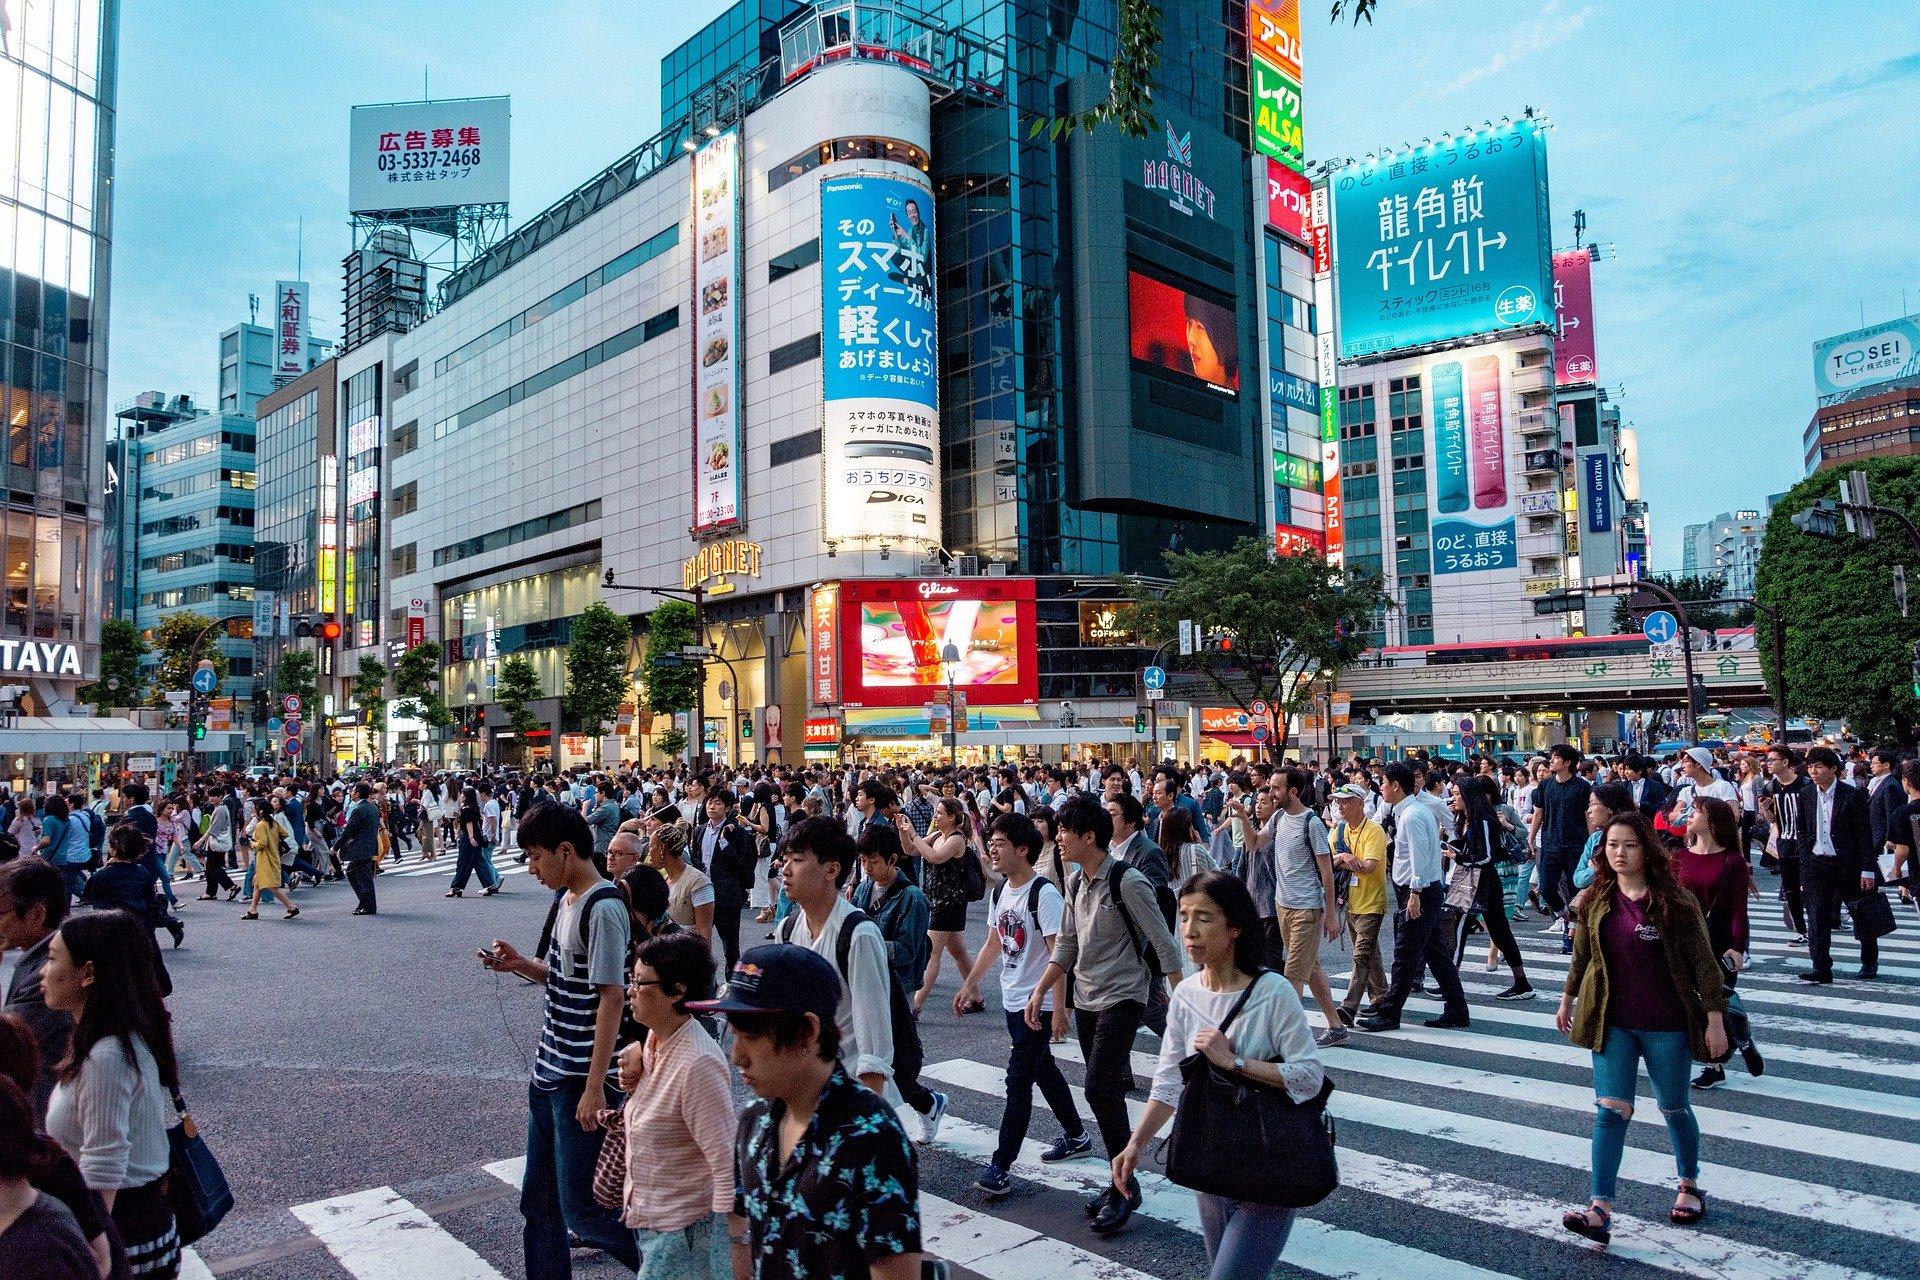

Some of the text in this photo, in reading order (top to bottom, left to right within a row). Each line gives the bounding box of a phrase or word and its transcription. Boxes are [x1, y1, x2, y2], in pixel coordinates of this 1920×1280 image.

[1259, 15, 1302, 67] アコム
[1257, 69, 1300, 118] レイク
[378, 126, 481, 152] 広告募集
[1257, 105, 1302, 152] ALSA
[378, 148, 481, 171] 03-5337-2468
[388, 167, 471, 183] 株式会社タップ
[826, 183, 863, 193] Panasonic
[1143, 159, 1216, 220] MAGNET
[1269, 178, 1311, 218] アイフル
[1378, 174, 1484, 242] 龍角散
[837, 218, 875, 237] その
[1317, 236, 1328, 272] アイフル
[1366, 227, 1508, 291] ダイレクト
[1380, 291, 1437, 312] スティック
[1498, 296, 1533, 316] 生薬
[282, 288, 301, 355] 大和証券
[838, 305, 932, 354] 軽くして
[1567, 360, 1592, 374] 生薬
[1833, 340, 1899, 368] TOSEI
[1271, 377, 1315, 407] レオパレス21
[849, 411, 932, 429] スマホの写真や動画は
[1273, 457, 1297, 475] レイク
[1594, 459, 1603, 491] MIZUHO
[1327, 496, 1340, 528] アコム
[1437, 529, 1515, 551] のど、直接、
[683, 540, 762, 590] MAGNET
[1445, 550, 1504, 570] うるおう
[918, 582, 959, 599] Glico
[0, 639, 82, 675] TAYA
[816, 608, 832, 700] 天津甘栗
[1585, 662, 1608, 675] JR
[805, 724, 836, 737] 天津甘栗
